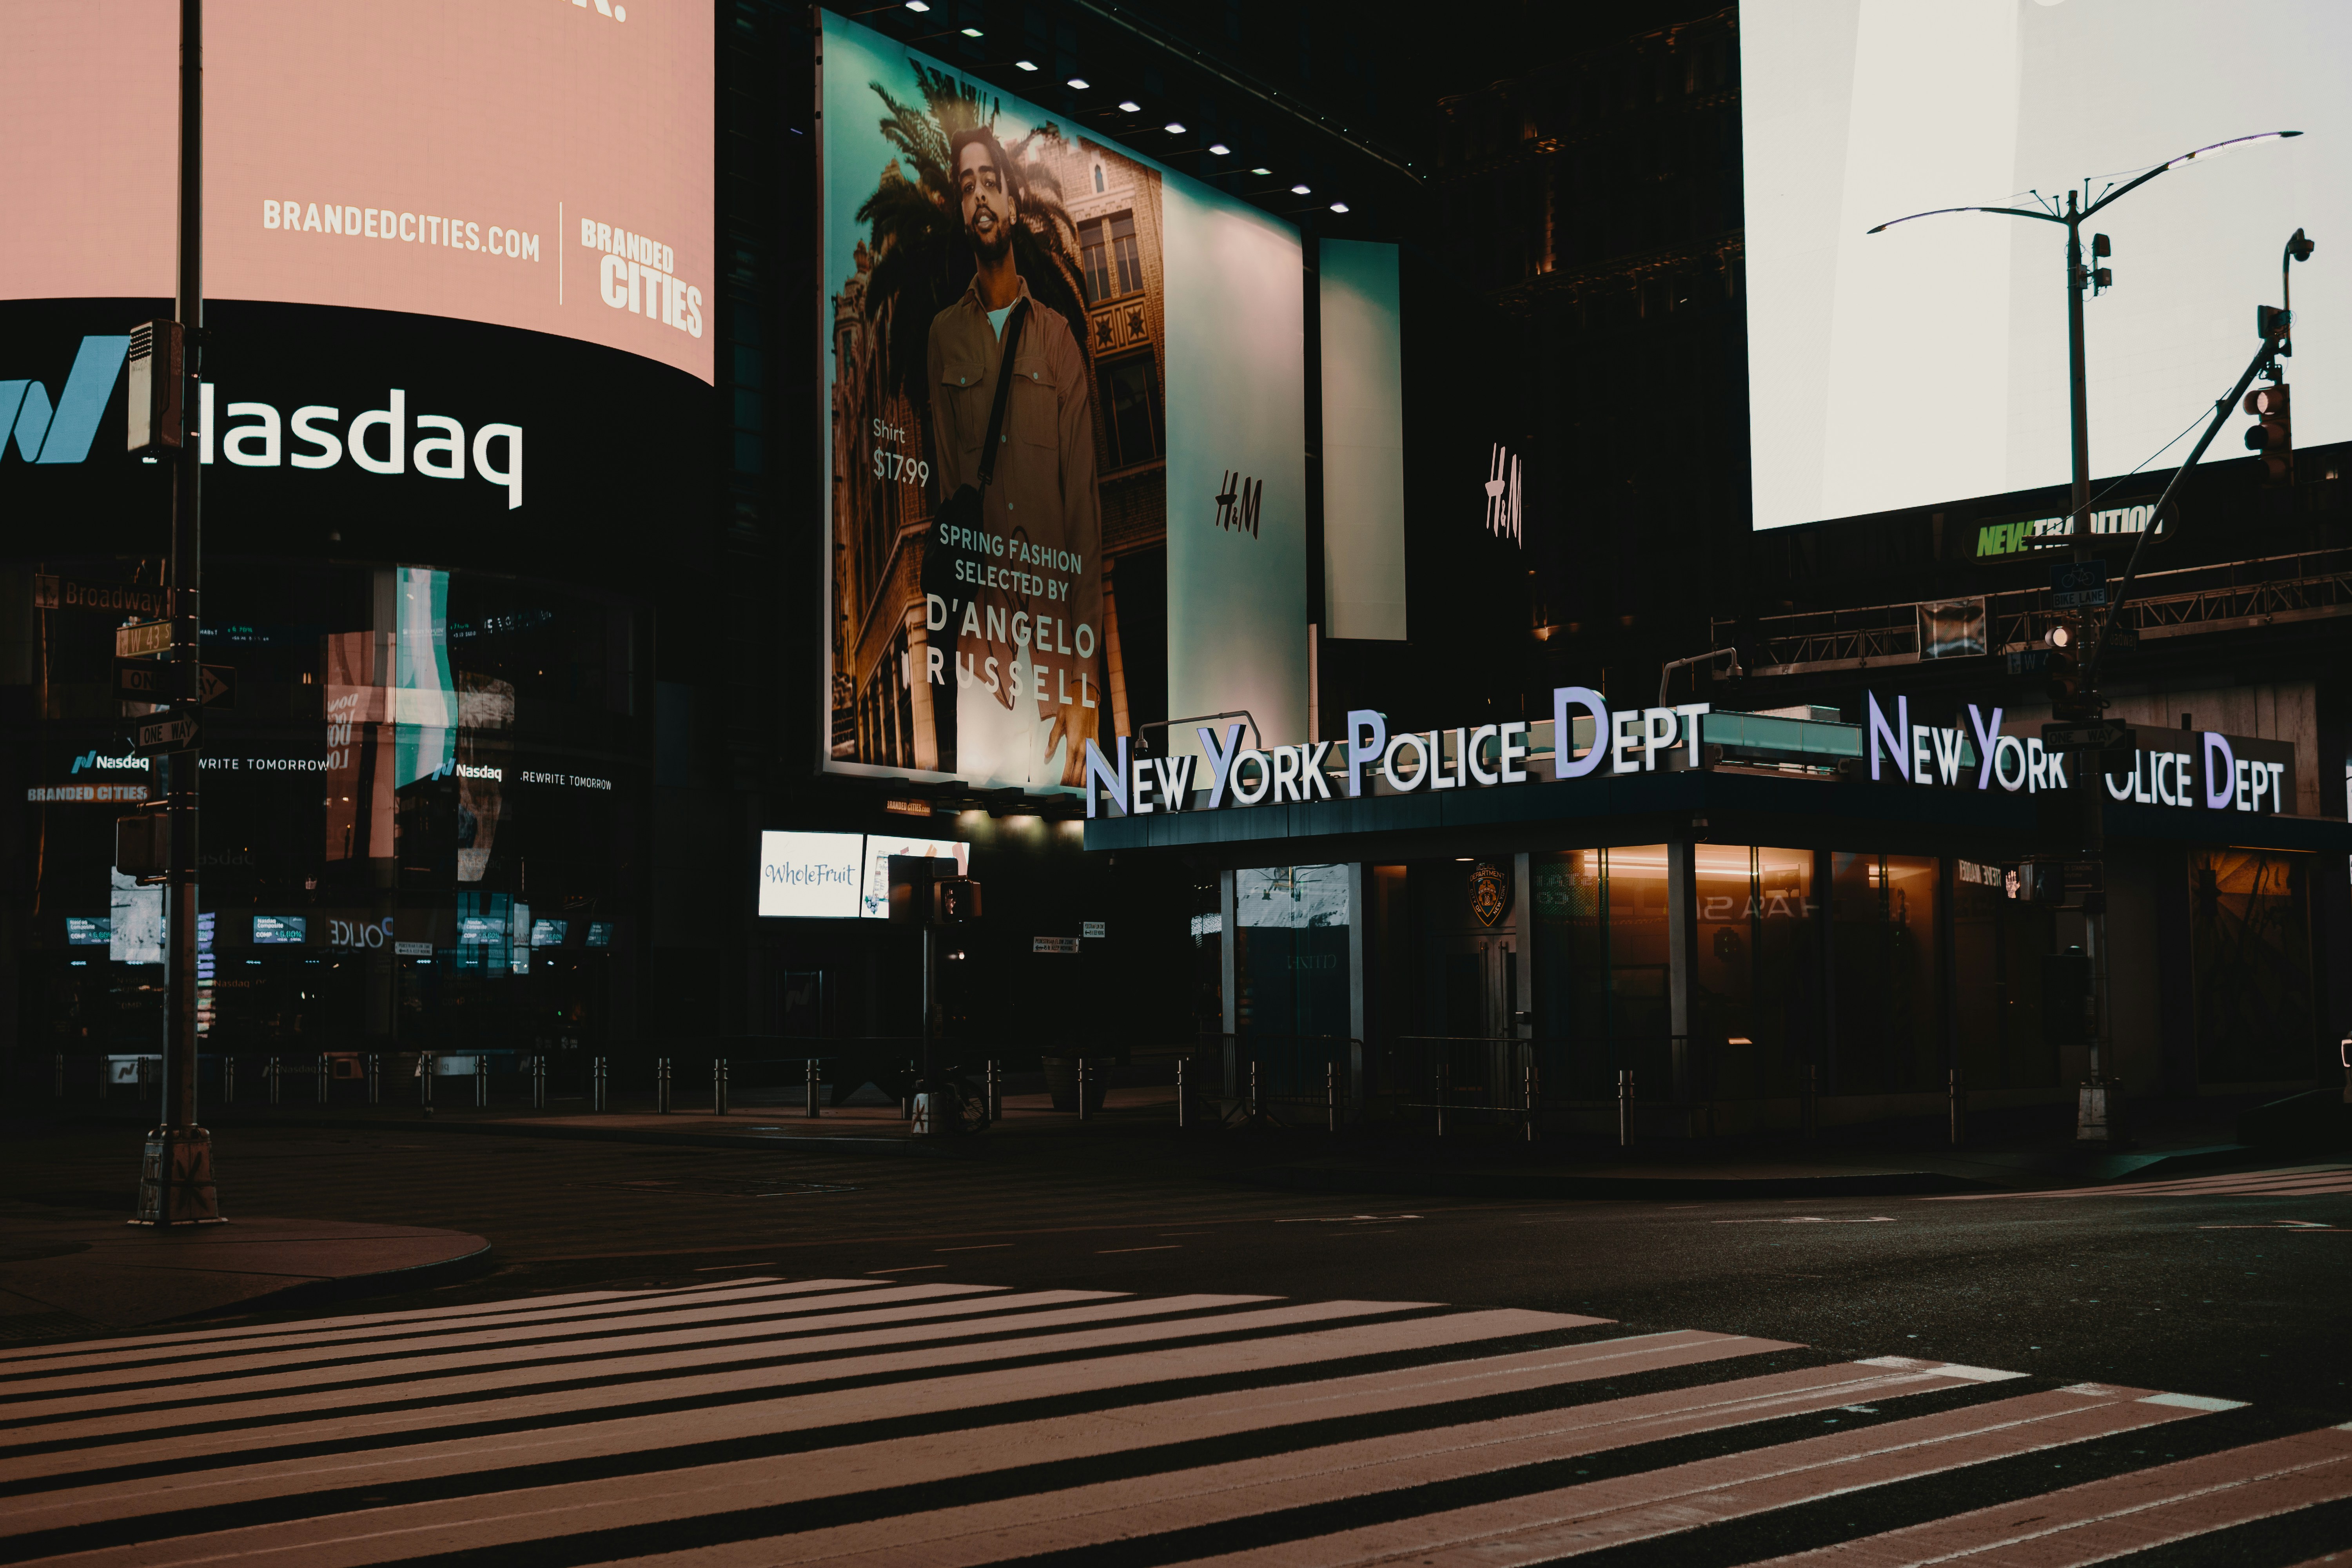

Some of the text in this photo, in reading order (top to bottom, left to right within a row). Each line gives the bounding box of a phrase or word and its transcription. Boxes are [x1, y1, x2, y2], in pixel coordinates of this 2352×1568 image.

[263, 200, 539, 262] BRANDEDCITIES.COM
[581, 218, 673, 274] BRANDED
[600, 254, 702, 339] CITIES
[873, 417, 905, 444] Shirt
[873, 446, 929, 488] $17.99
[1215, 469, 1262, 540] H&M
[1485, 440, 1522, 550] H&M
[940, 523, 1082, 575] SPRING FASHION
[955, 559, 1068, 602] SELECTED BY
[66, 582, 163, 618] Broadway
[2054, 590, 2103, 606] BIKE LANE
[131, 630, 141, 652] W
[146, 626, 159, 649] 43
[927, 593, 1095, 658] D'ANGELO
[2109, 632, 2137, 652] oadway
[2024, 652, 2036, 666] W
[131, 671, 218, 695] ONE AY
[927, 647, 1095, 708] RUSSELL
[144, 720, 192, 744] ONE WAY
[2049, 729, 2114, 744] ONE WAY
[96, 755, 329, 771] Nasdaq WRITE TOMORROW
[1086, 686, 1711, 818] NEW YORK POLICE DEPT
[1867, 689, 2285, 813] NEW YORK OLICE DEPT
[456, 764, 612, 791] Nasdaq REWRITE TOMORROW
[27, 786, 148, 801] BRANDED CITIES
[887, 800, 930, 813] BRANDED CITIES.com
[199, 848, 254, 870] asdaq
[765, 861, 856, 886] WholeFruit
[1470, 870, 1505, 882] DEPARTMENT
[1493, 901, 1502, 915] NEW
